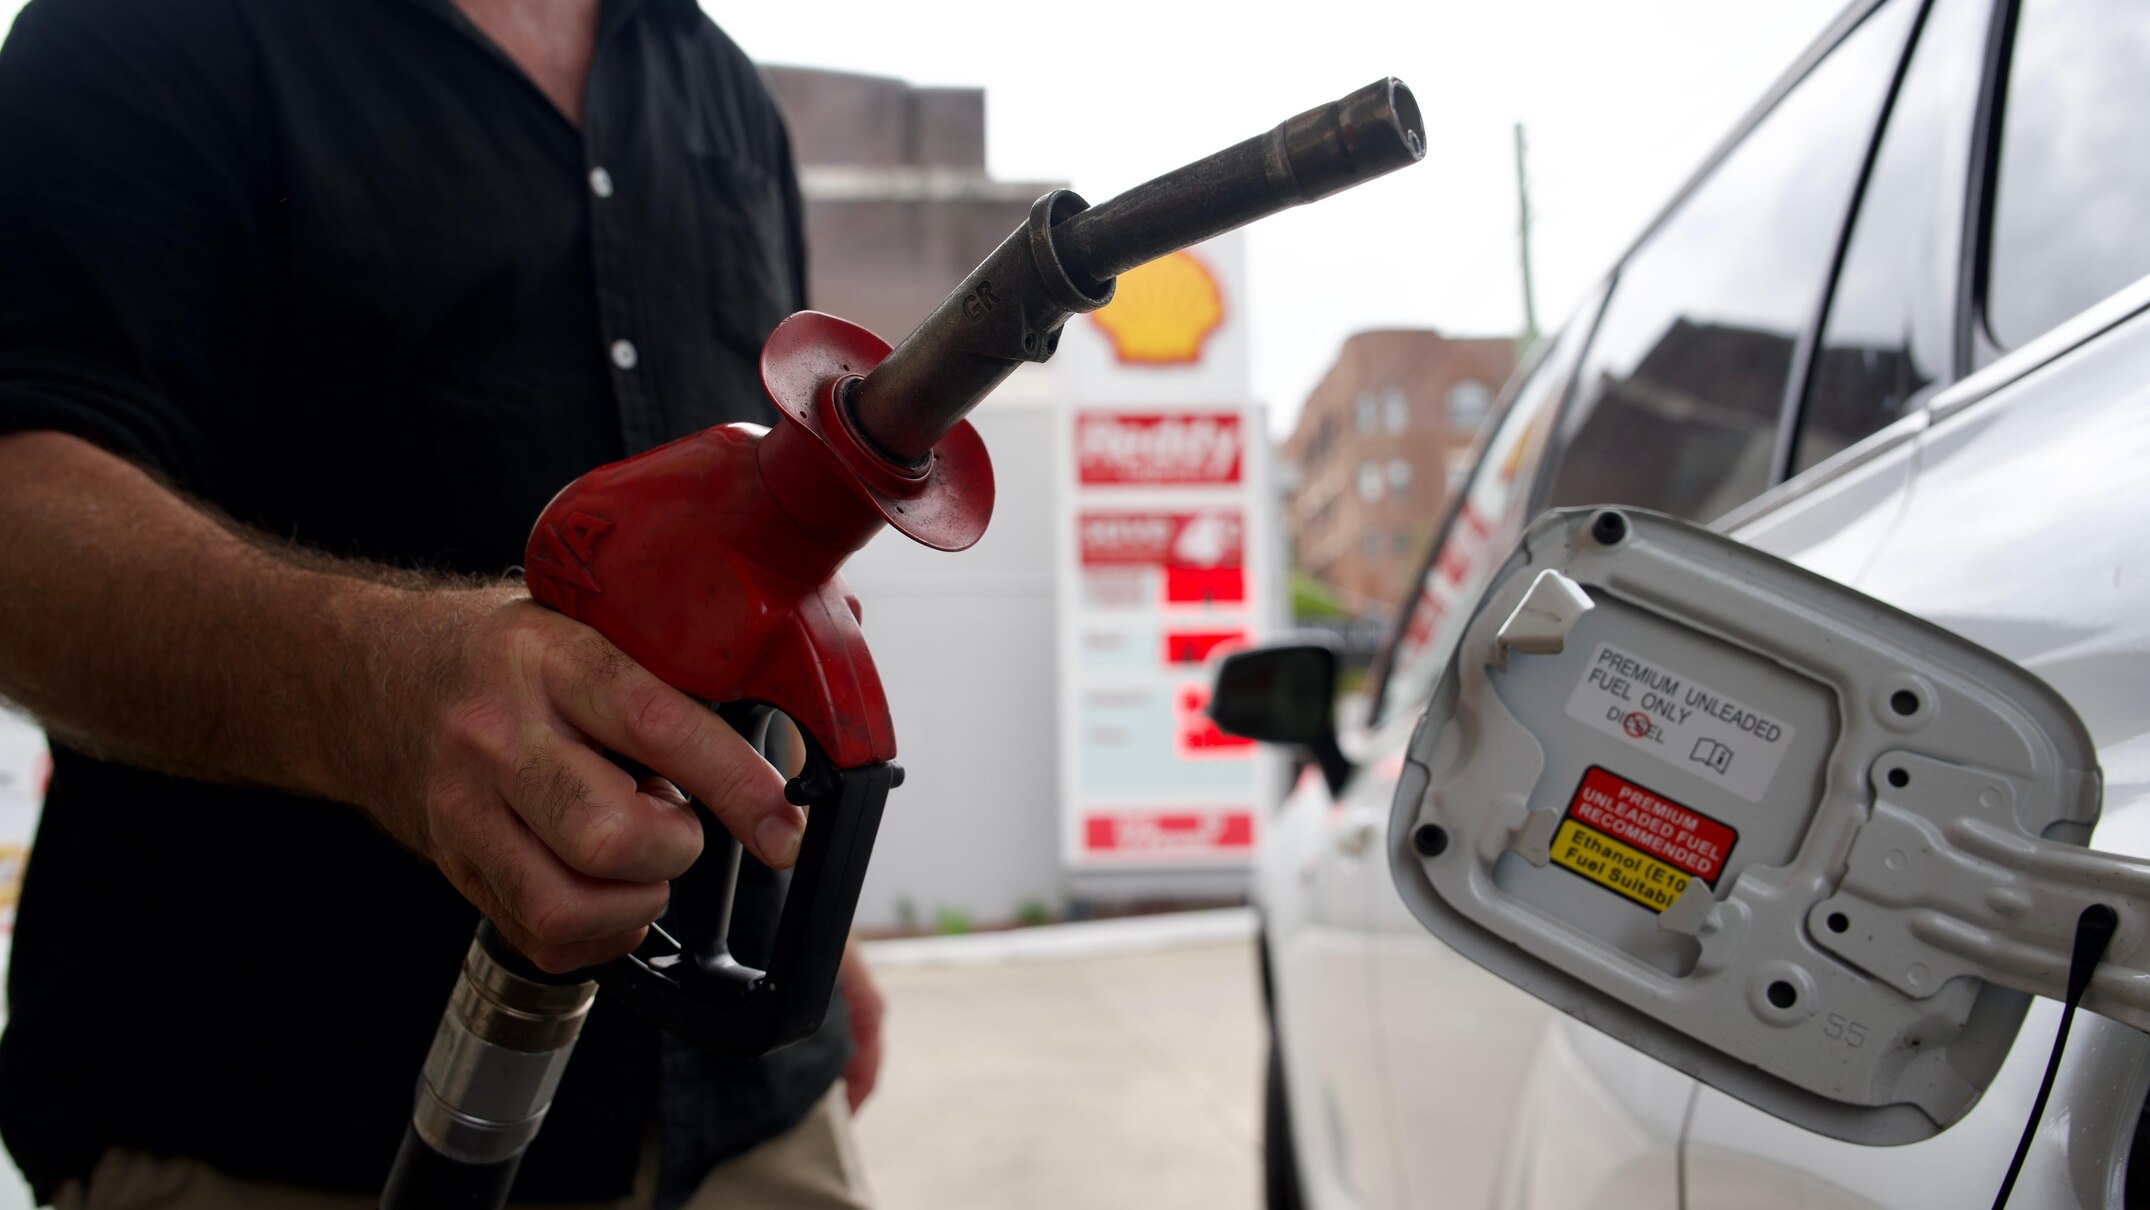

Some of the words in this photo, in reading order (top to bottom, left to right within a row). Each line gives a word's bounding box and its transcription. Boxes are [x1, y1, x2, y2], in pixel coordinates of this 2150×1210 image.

[962, 280, 1001, 320] GR
[1587, 668, 1632, 702] FUEL
[1641, 692, 1693, 725] ONLY
[1598, 648, 1680, 698] PREMIUM
[1685, 688, 1783, 743] UNLEADED
[1583, 787, 1675, 838] UNLEADED
[1676, 832, 1720, 862] FUEL
[1618, 786, 1699, 832] PREMIUM
[1572, 830, 1643, 872] Ethanol
[1578, 803, 1713, 874] RECOMMENDED
[1565, 846, 1606, 875] Fuel
[1608, 865, 1675, 907] Suitabl
[1823, 1012, 1869, 1048] 55
